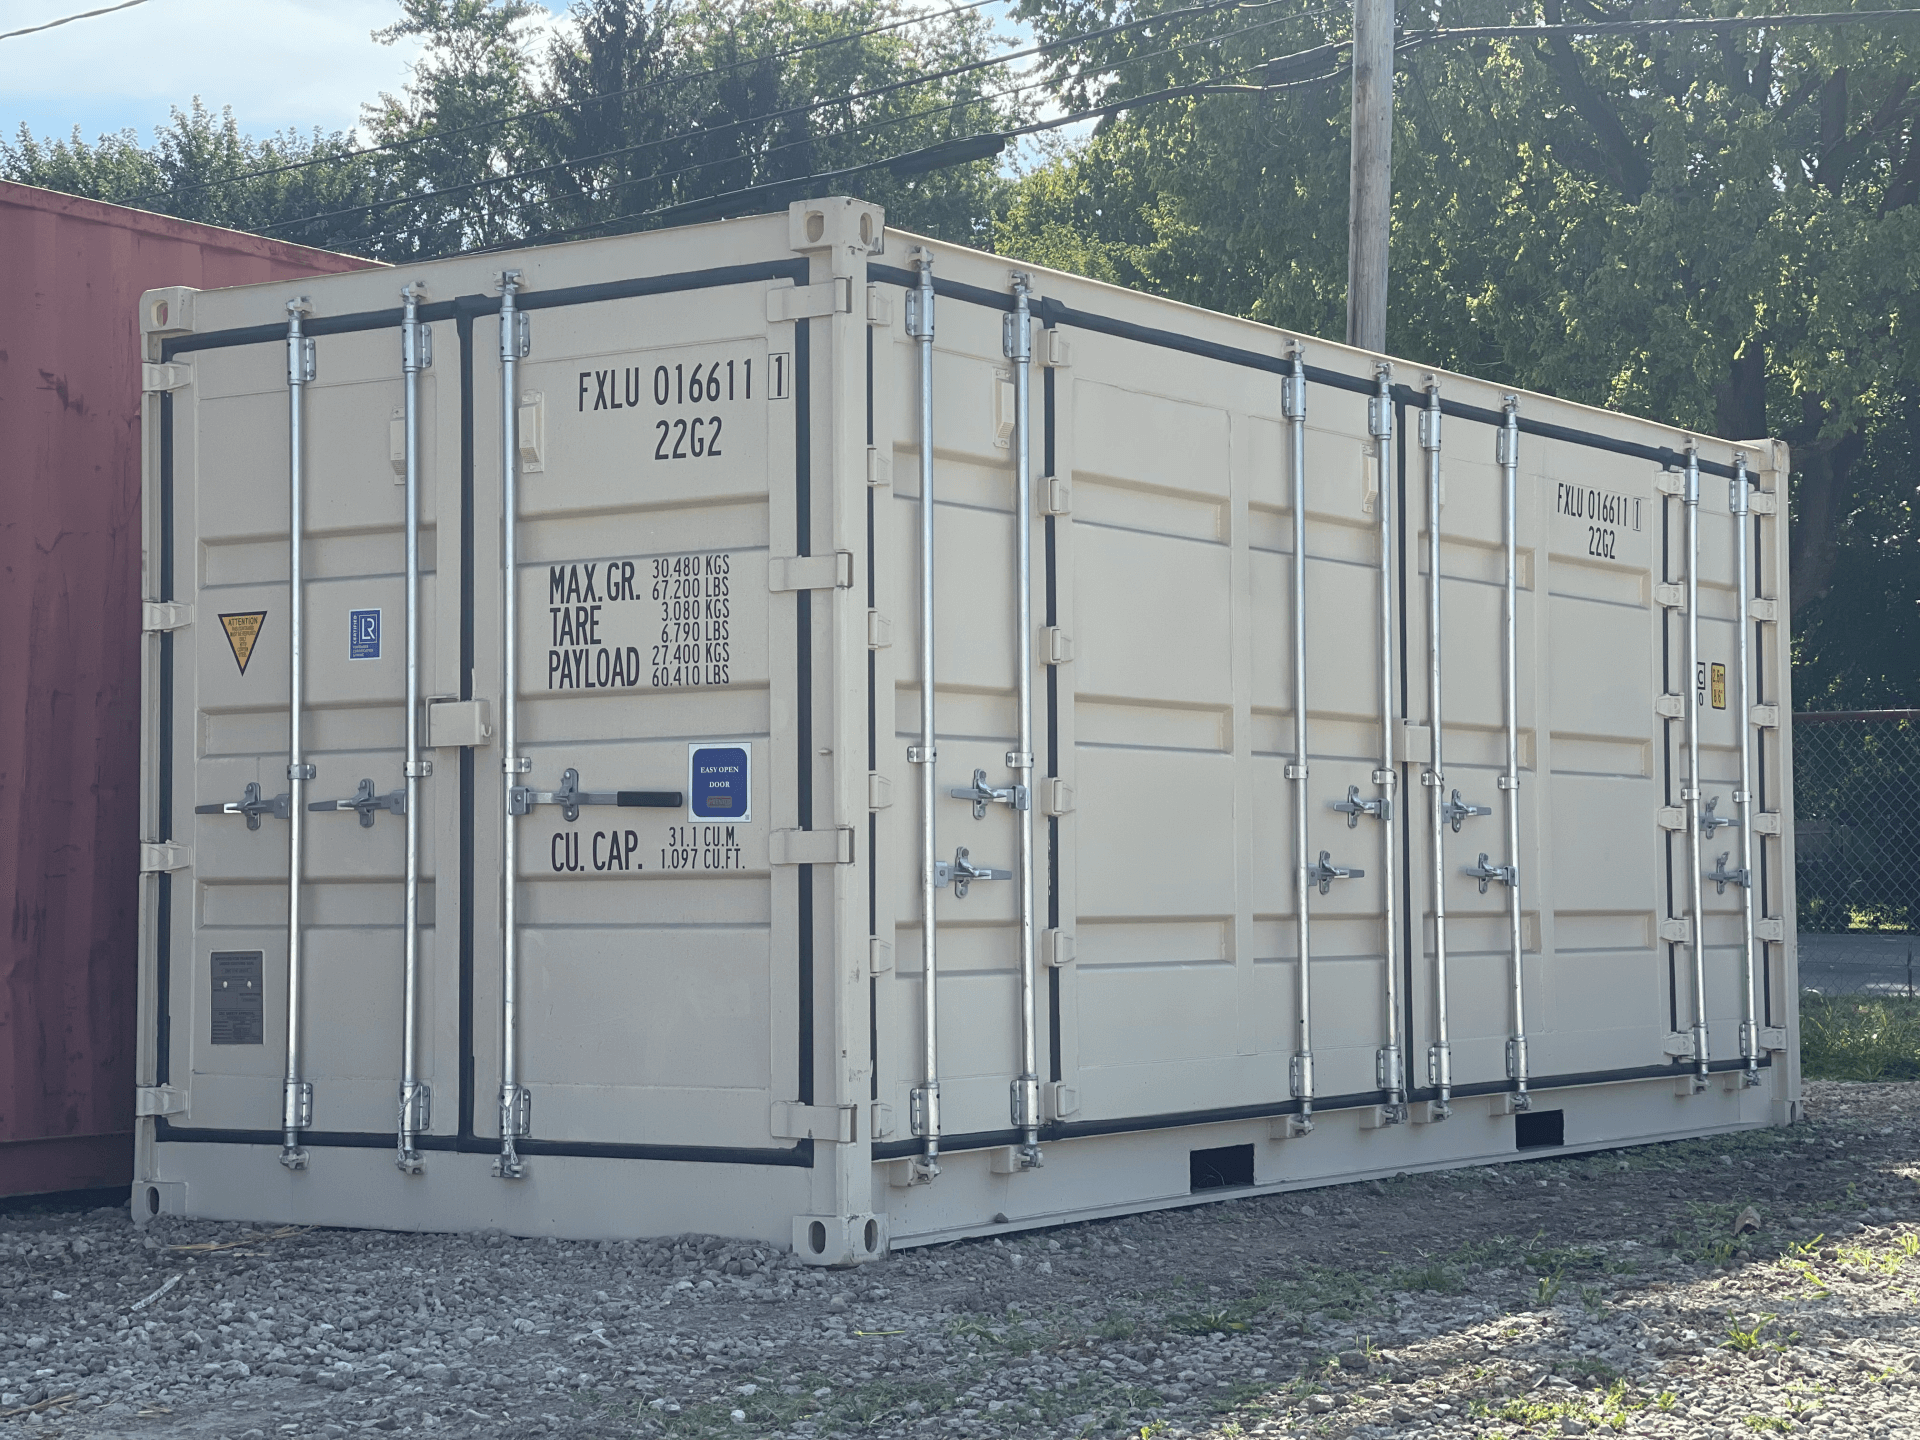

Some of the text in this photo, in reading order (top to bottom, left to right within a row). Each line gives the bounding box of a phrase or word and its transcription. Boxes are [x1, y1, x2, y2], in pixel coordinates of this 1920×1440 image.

[578, 355, 783, 412] FXLU 016611 1
[654, 416, 722, 460] 22G2
[1557, 482, 1584, 518] FXLU
[1587, 490, 1628, 527] 016611
[1588, 525, 1616, 560] 22G2
[652, 556, 701, 579] 30,480
[705, 554, 730, 576] KGS
[652, 576, 729, 601] 67,200 LBS
[227, 616, 259, 627] ATTENTION
[549, 598, 730, 647] TARE 3,080 KGS
[661, 620, 729, 644] 6,790 LBS
[548, 642, 730, 690] PAYLOAD 27,400 KGS
[705, 664, 729, 686] LBS
[700, 765, 739, 774] EASY OPEN
[551, 831, 585, 872] CU.
[592, 830, 643, 871] CAP.
[668, 826, 697, 847] 31.1
